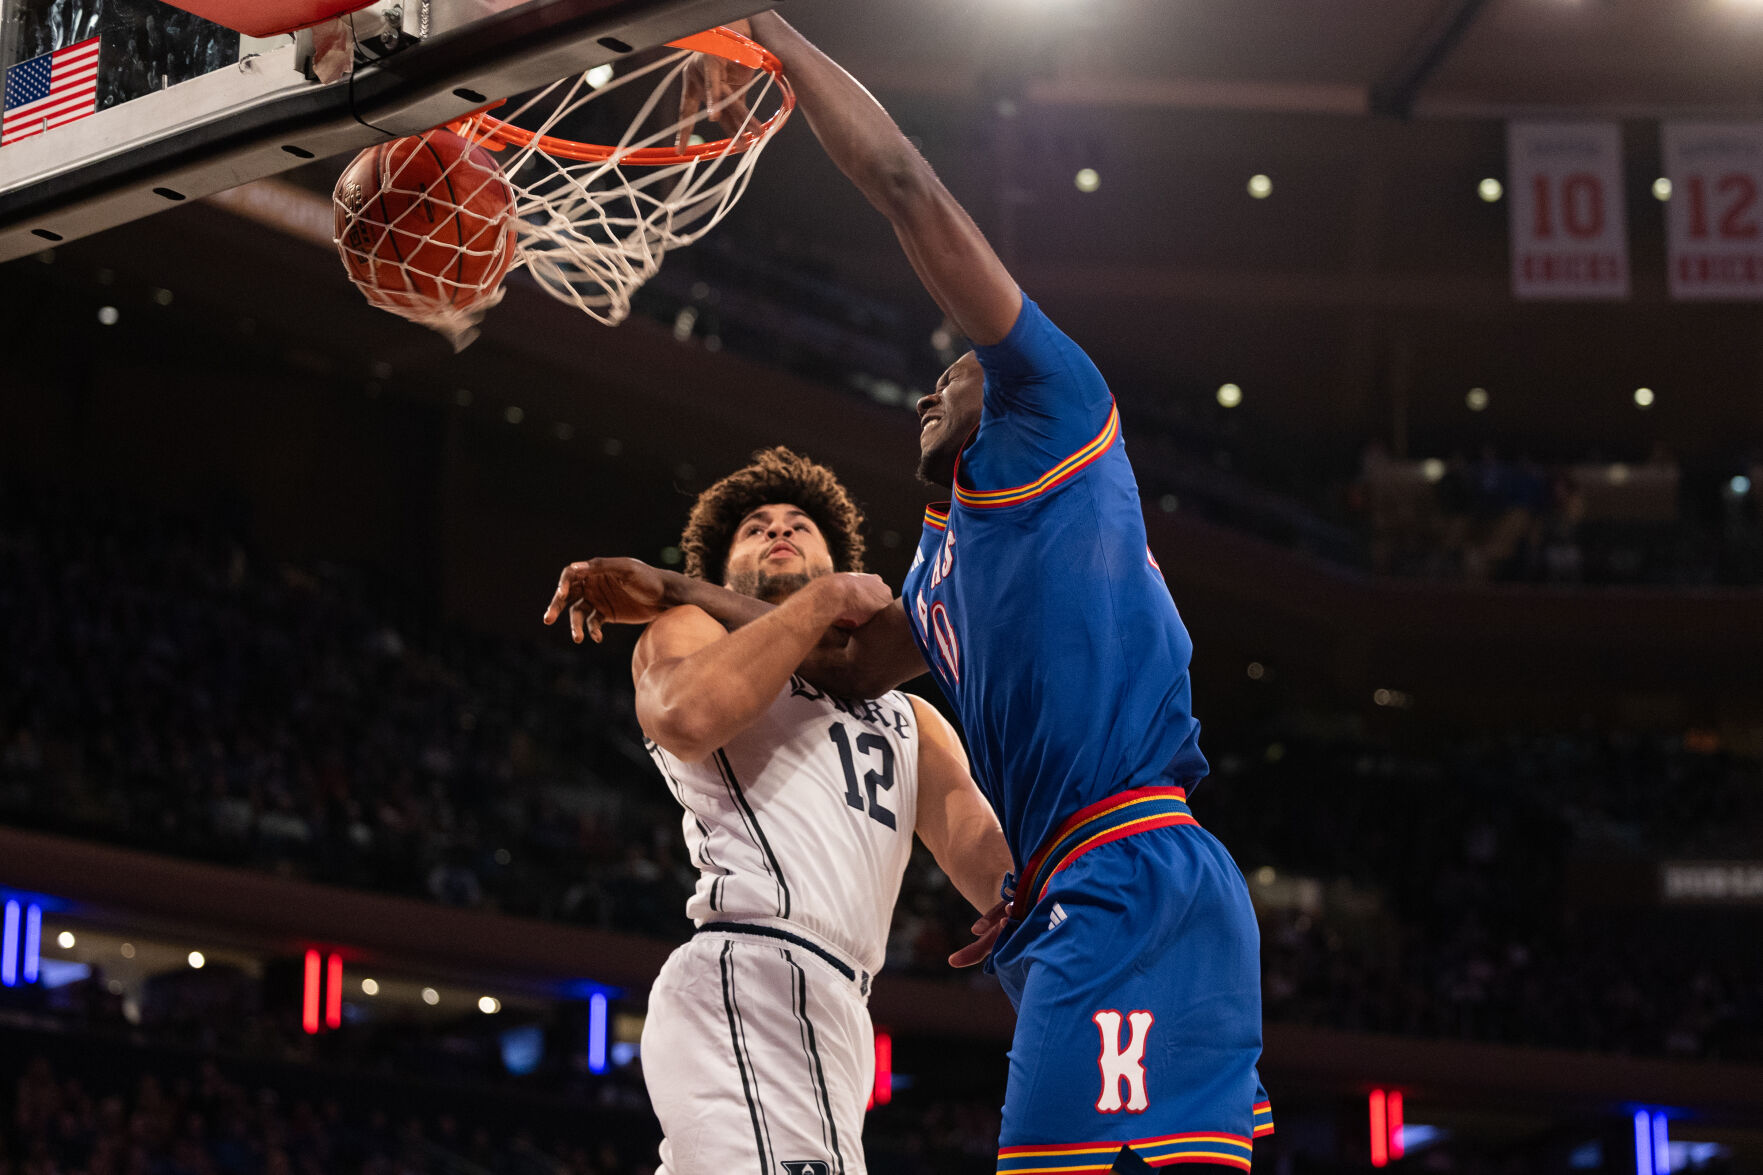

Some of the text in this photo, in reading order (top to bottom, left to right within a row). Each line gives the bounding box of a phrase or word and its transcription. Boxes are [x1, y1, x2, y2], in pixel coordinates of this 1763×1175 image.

[1532, 172, 1605, 241] 10
[1687, 172, 1759, 241] 12
[828, 721, 897, 832] 12
[1092, 1008, 1155, 1115] K
